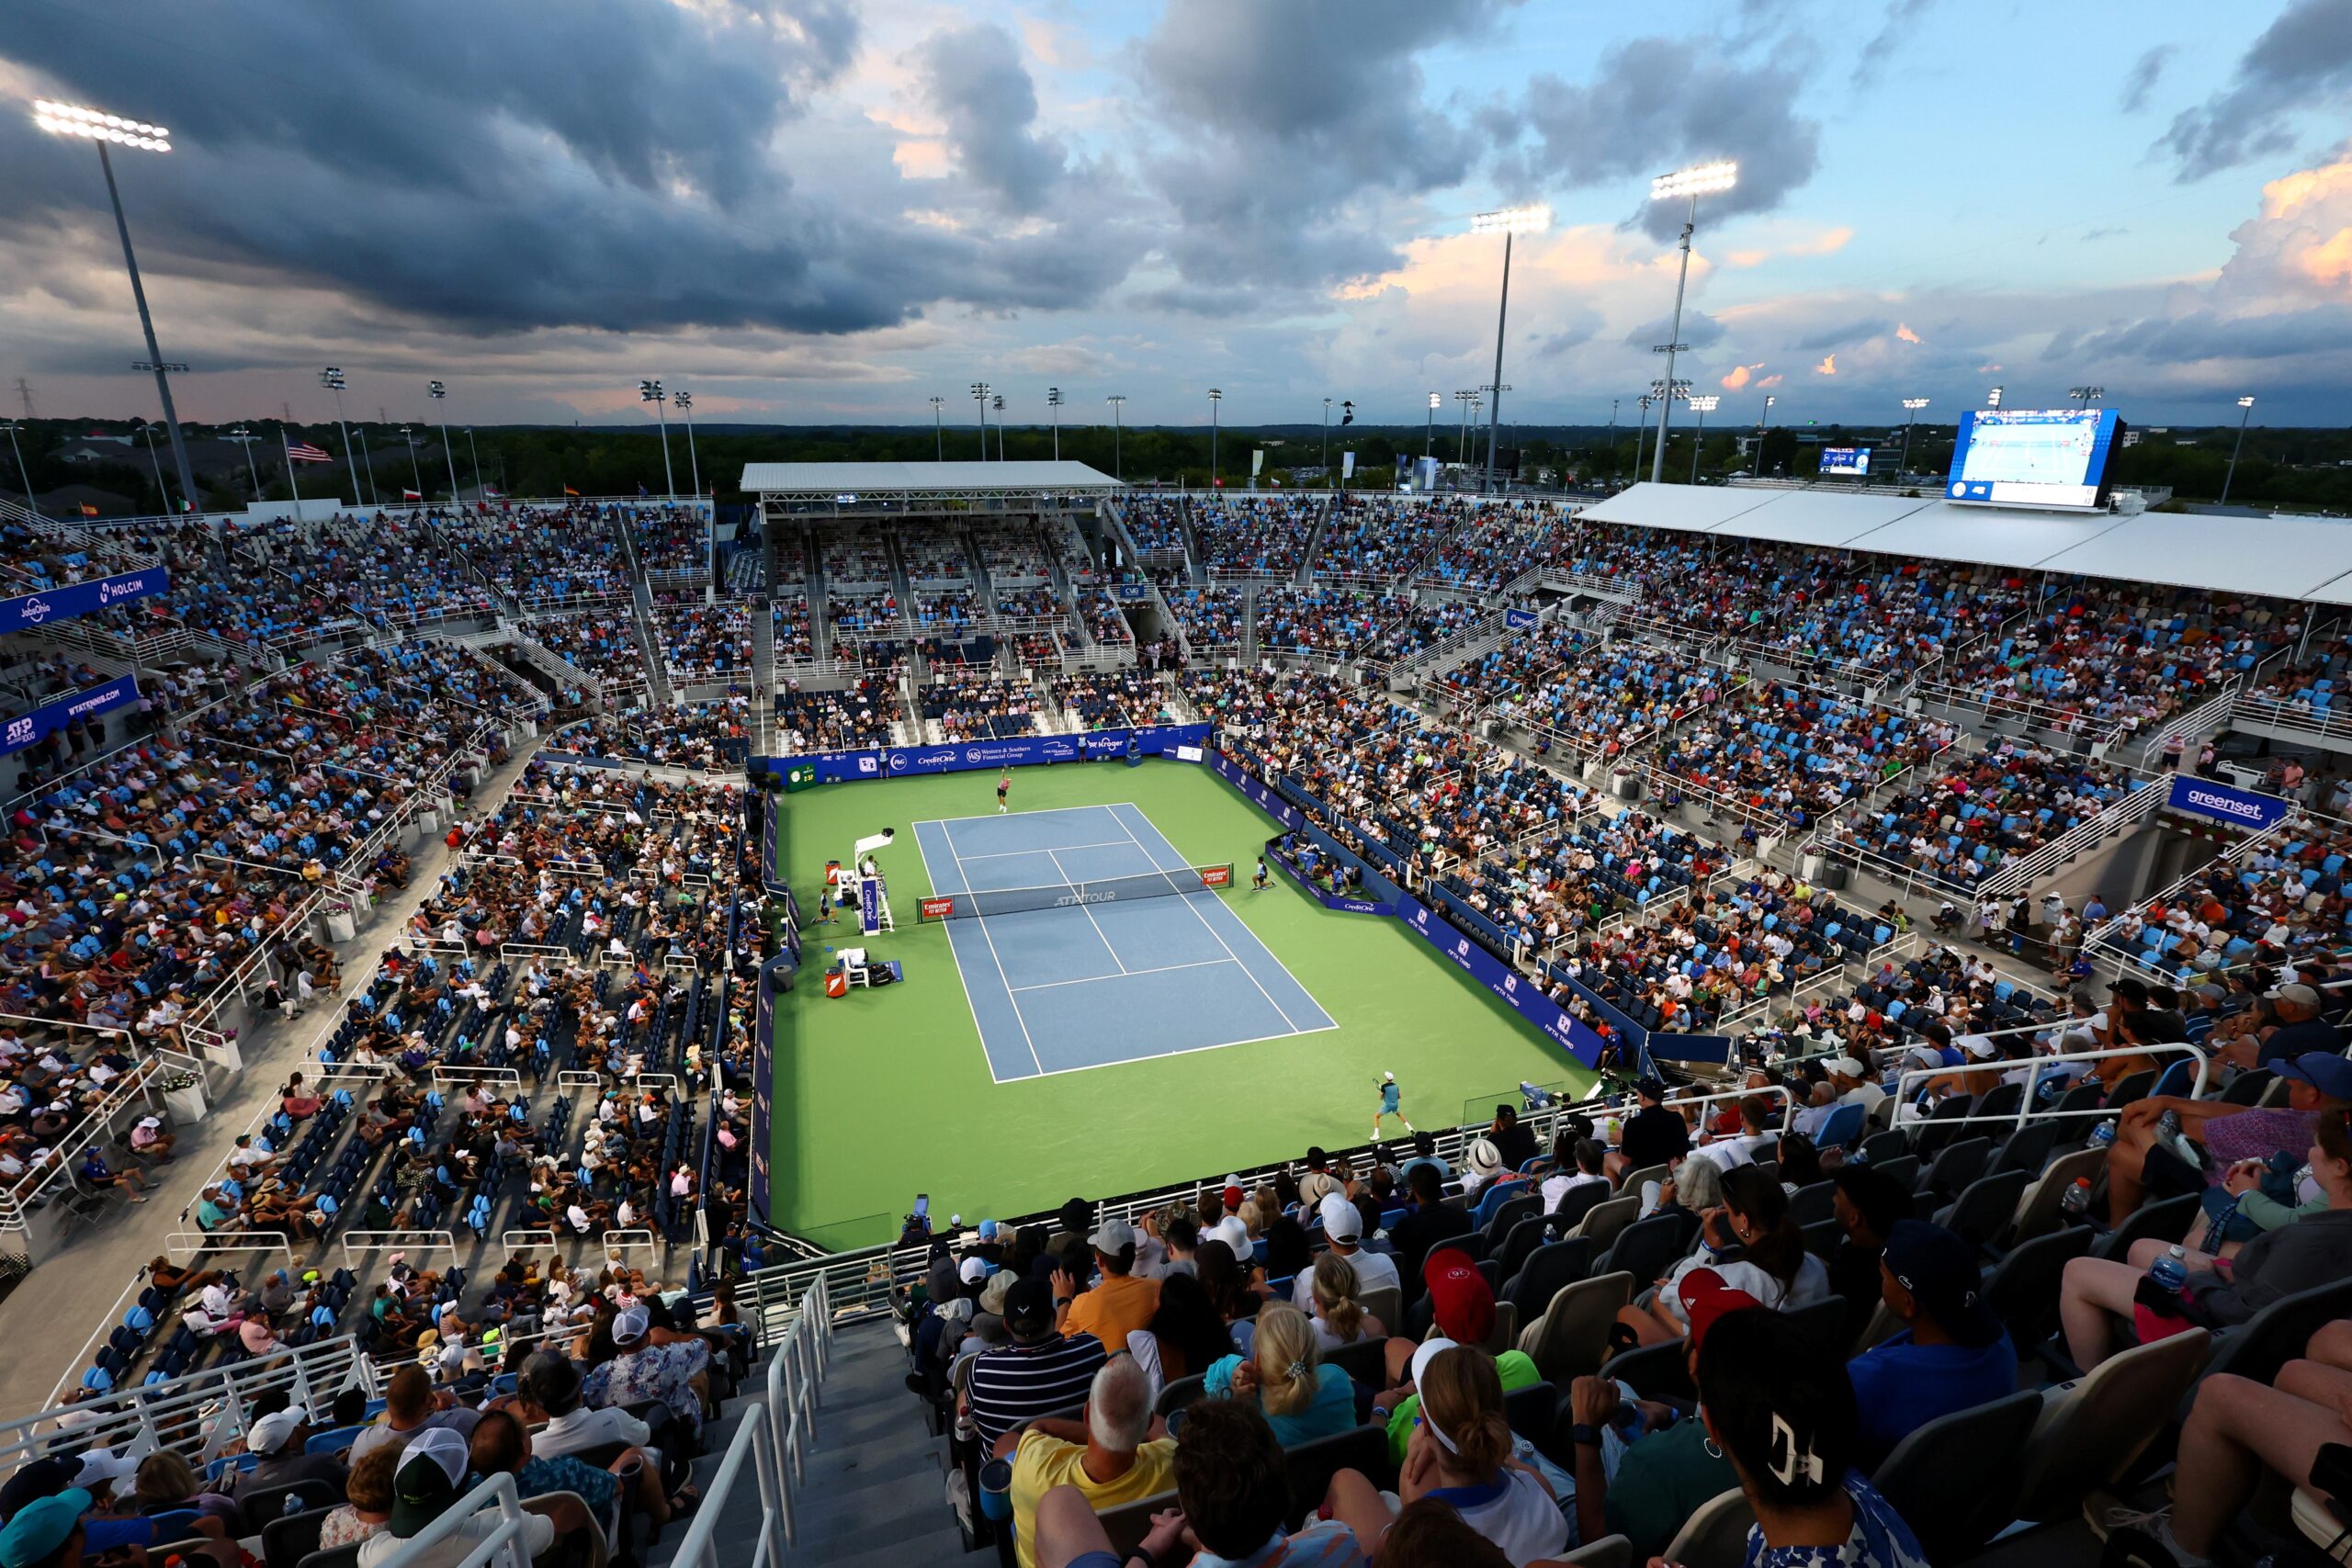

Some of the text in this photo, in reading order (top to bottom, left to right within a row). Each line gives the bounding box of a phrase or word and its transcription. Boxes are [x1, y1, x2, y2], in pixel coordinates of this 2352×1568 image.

[111, 581, 143, 596] HOLCIM
[21, 604, 51, 618] JobsOhio
[68, 689, 120, 716] WTATENNIS.COM
[6, 717, 33, 741] ATP
[1098, 737, 1124, 750] Kroger
[918, 755, 956, 764] CreditOne
[2188, 790, 2264, 818] greenset.
[865, 889, 874, 921] CreditOne
[924, 902, 951, 910] Emirates
[1084, 891, 1115, 903] TOUR
[1344, 903, 1375, 911] CreditOne
[1408, 917, 1429, 936] FIFTH THIRD
[1447, 948, 1471, 969] FIFTH THIRD
[1493, 984, 1520, 1007] FIFTH THIRD
[1544, 1023, 1574, 1049] FIFTH THIRD
